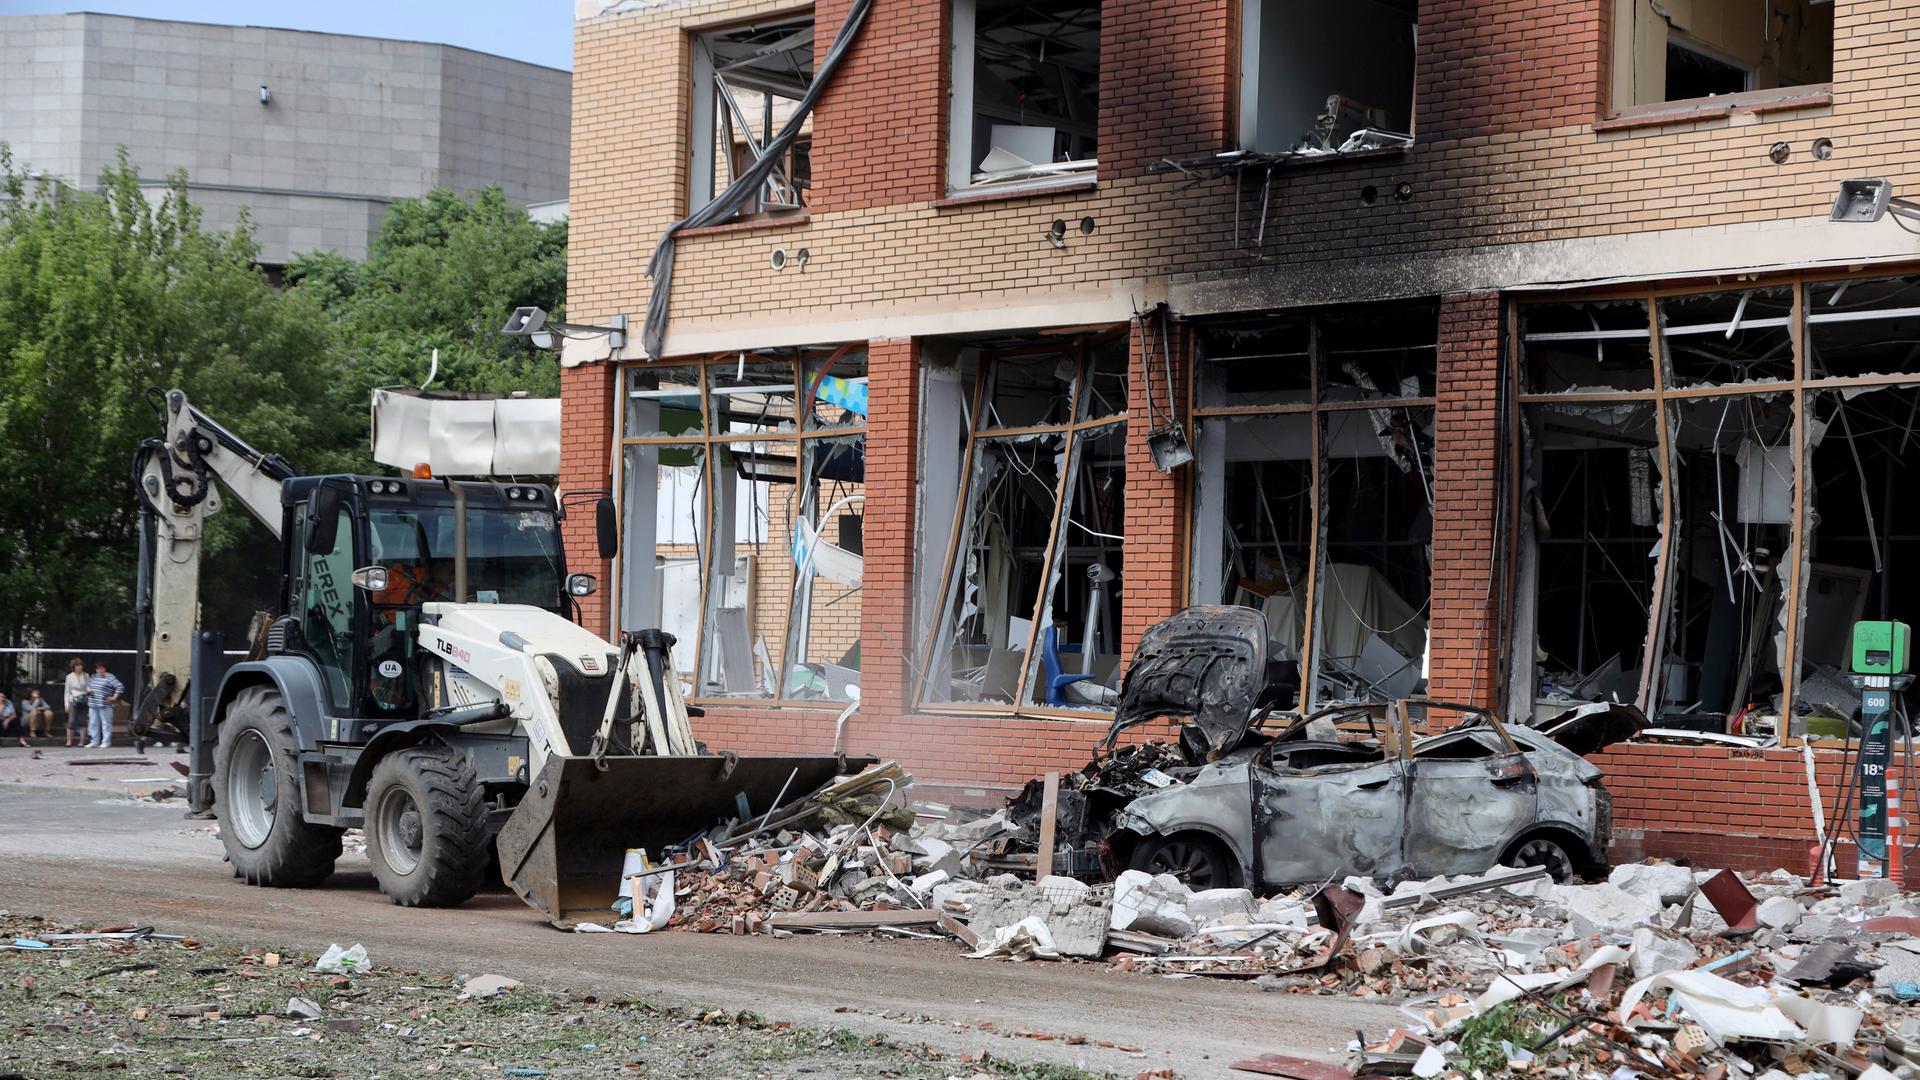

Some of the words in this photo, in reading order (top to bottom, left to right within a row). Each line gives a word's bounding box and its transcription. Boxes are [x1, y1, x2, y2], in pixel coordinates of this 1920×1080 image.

[313, 555, 345, 619] EREX
[384, 663, 397, 672] UA
[1867, 697, 1885, 707] 600
